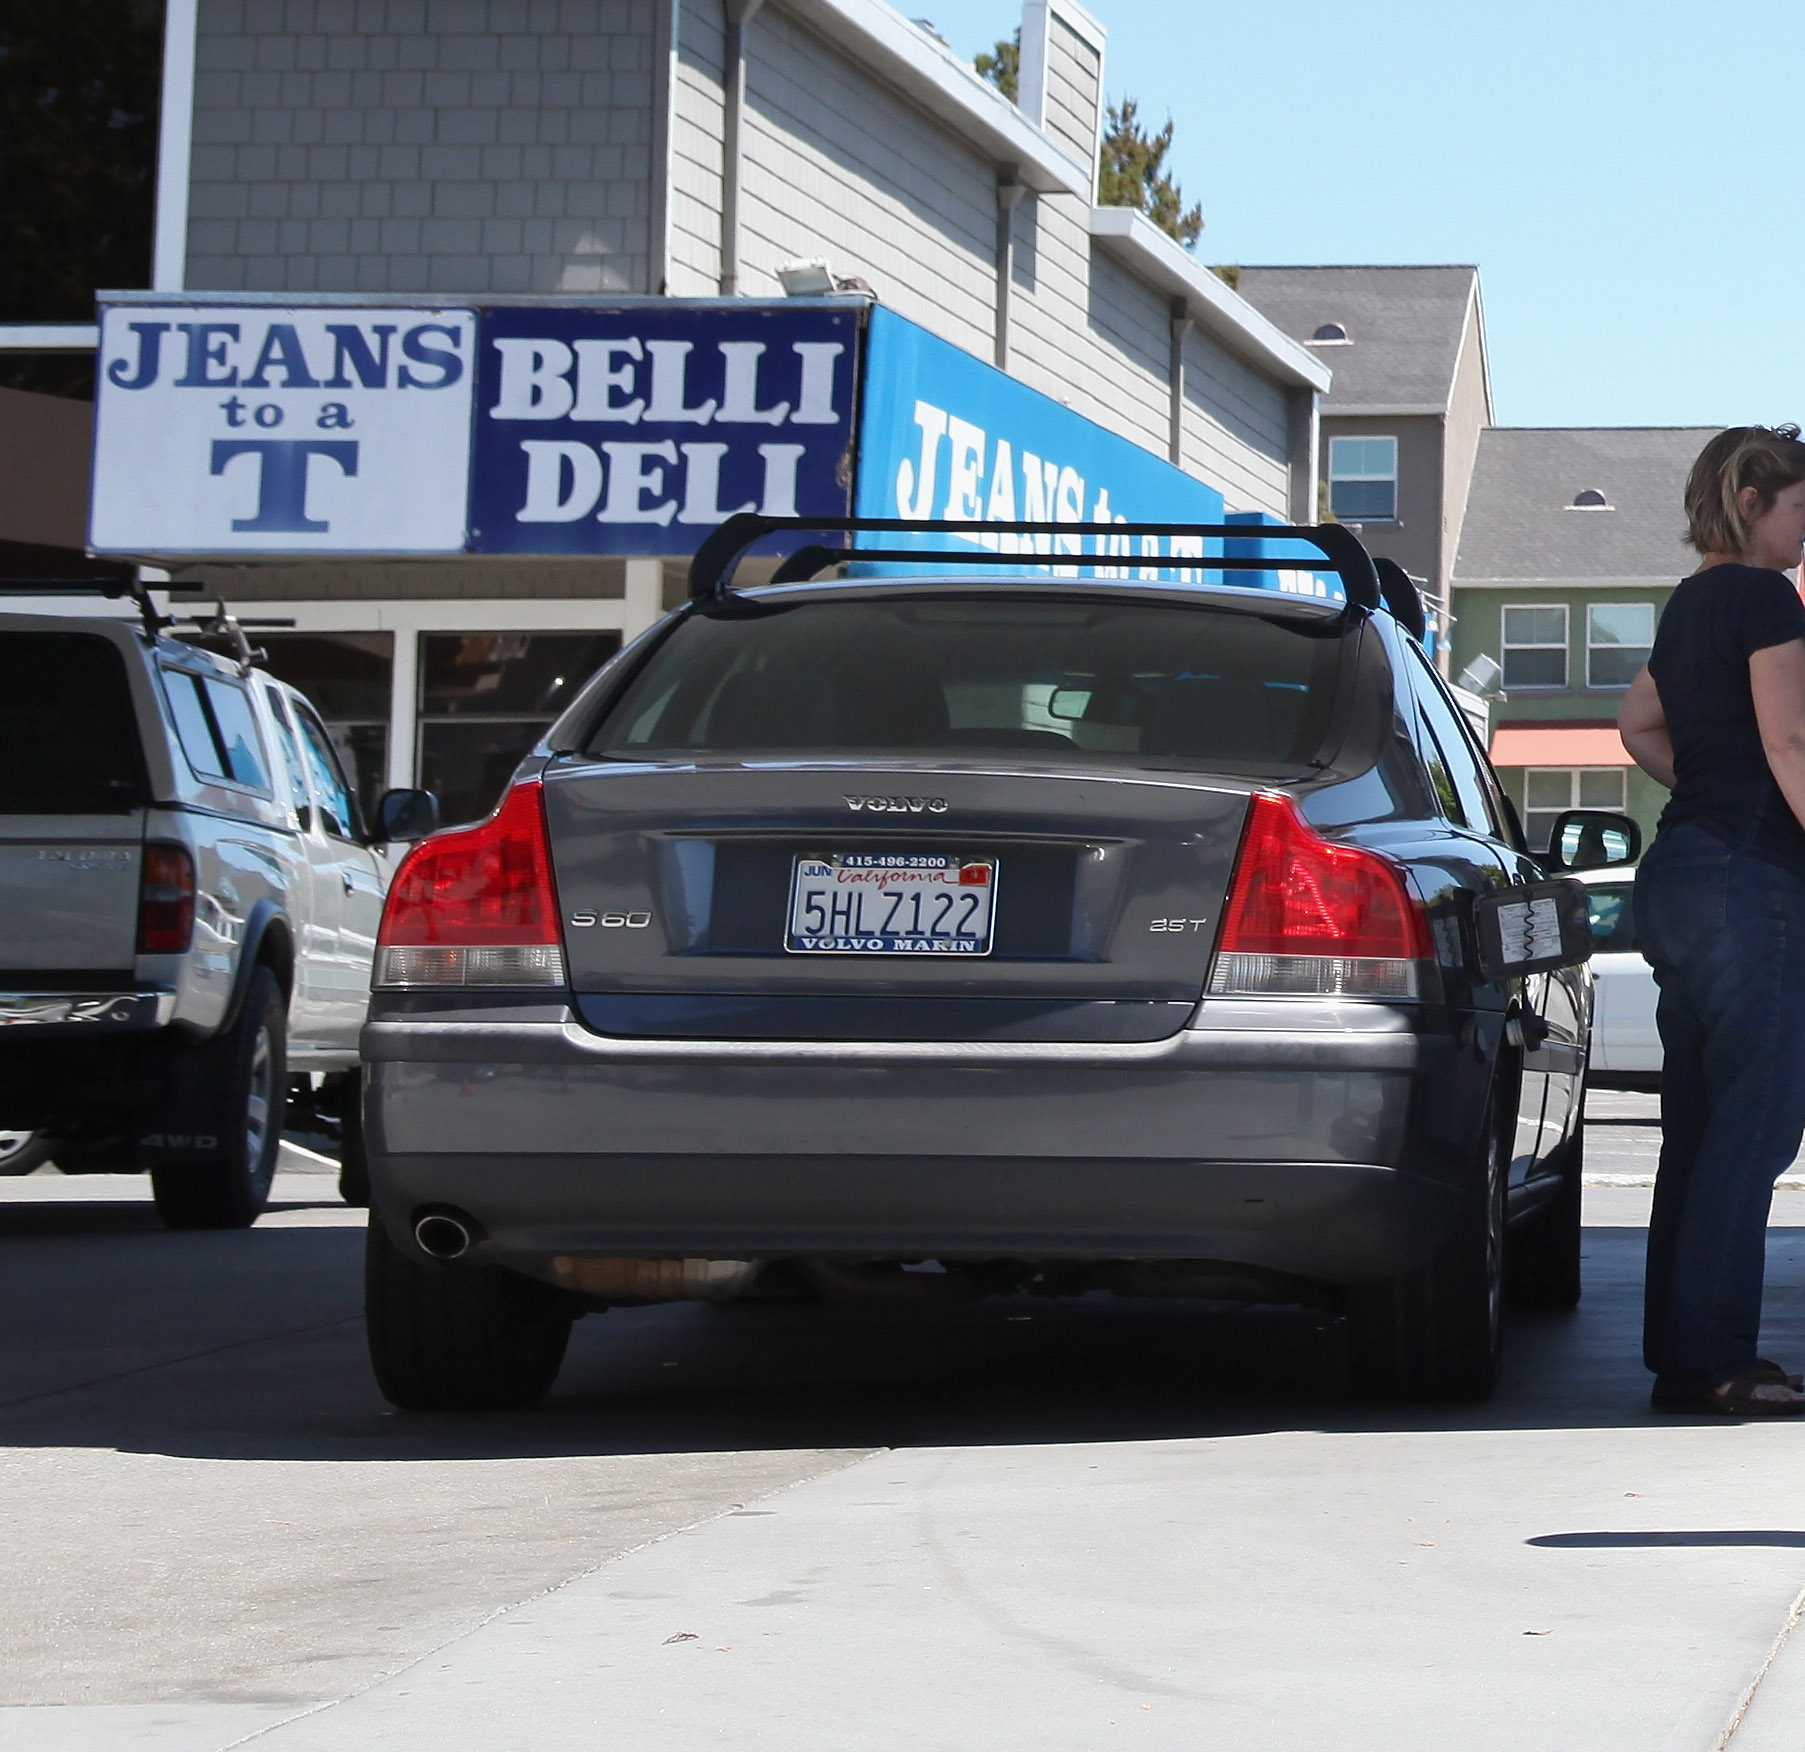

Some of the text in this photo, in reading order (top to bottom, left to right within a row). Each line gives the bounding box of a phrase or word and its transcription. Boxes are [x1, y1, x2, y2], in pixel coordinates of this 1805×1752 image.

[107, 321, 464, 391] JEANS
[489, 336, 845, 426] BELLI
[220, 396, 355, 430] to a
[209, 439, 360, 533] T
[516, 438, 806, 528] DELI
[895, 399, 1086, 579] JEANS
[1092, 487, 1131, 580] to
[842, 794, 949, 813] VOLVO
[803, 865, 832, 877] JUN
[837, 867, 958, 890] California
[845, 855, 947, 868] 415-496-2200
[804, 890, 980, 938] 5HLZ122
[801, 937, 976, 952] VOLVO MARIN
[140, 1134, 218, 1149] 4WD
